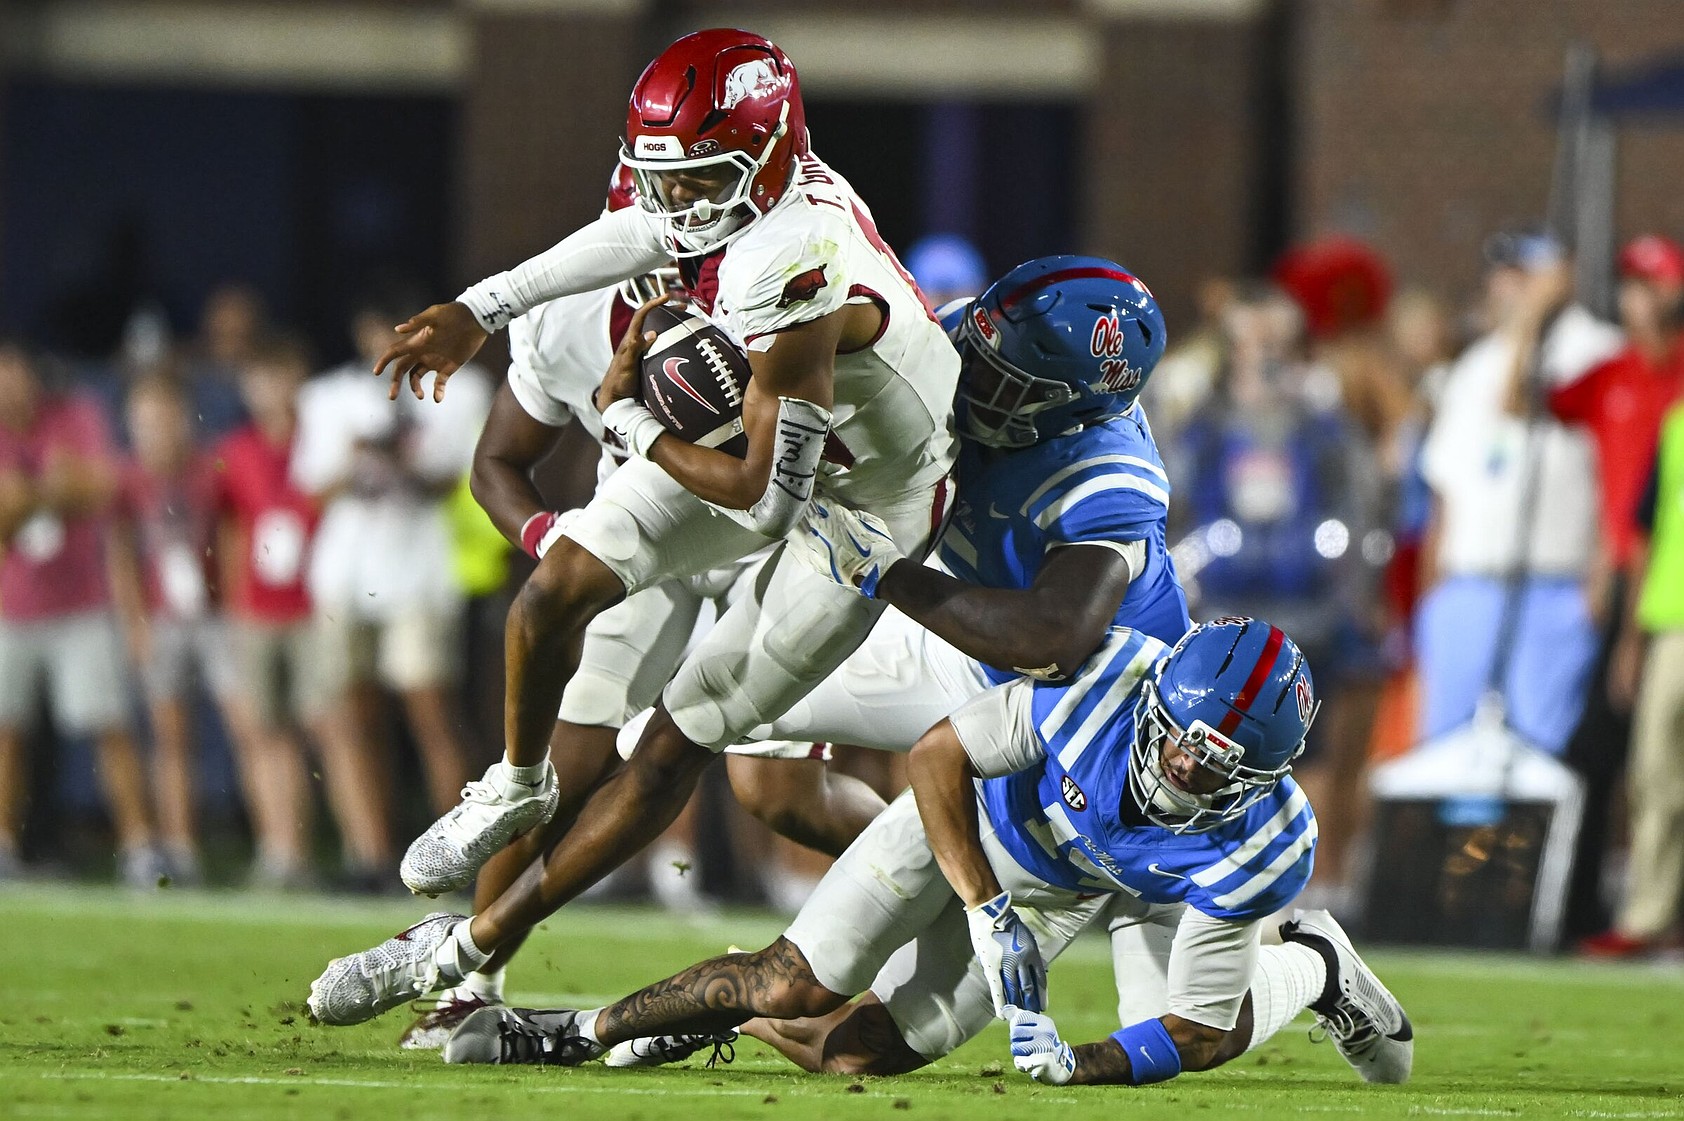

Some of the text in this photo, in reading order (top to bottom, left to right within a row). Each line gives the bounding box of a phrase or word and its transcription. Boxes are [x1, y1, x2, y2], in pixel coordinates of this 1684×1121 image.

[643, 142, 667, 152] HOGS
[1090, 316, 1124, 358] Ole
[1100, 358, 1142, 394] Miss
[1061, 775, 1086, 810] SEC
[1093, 849, 1124, 876] Miss
